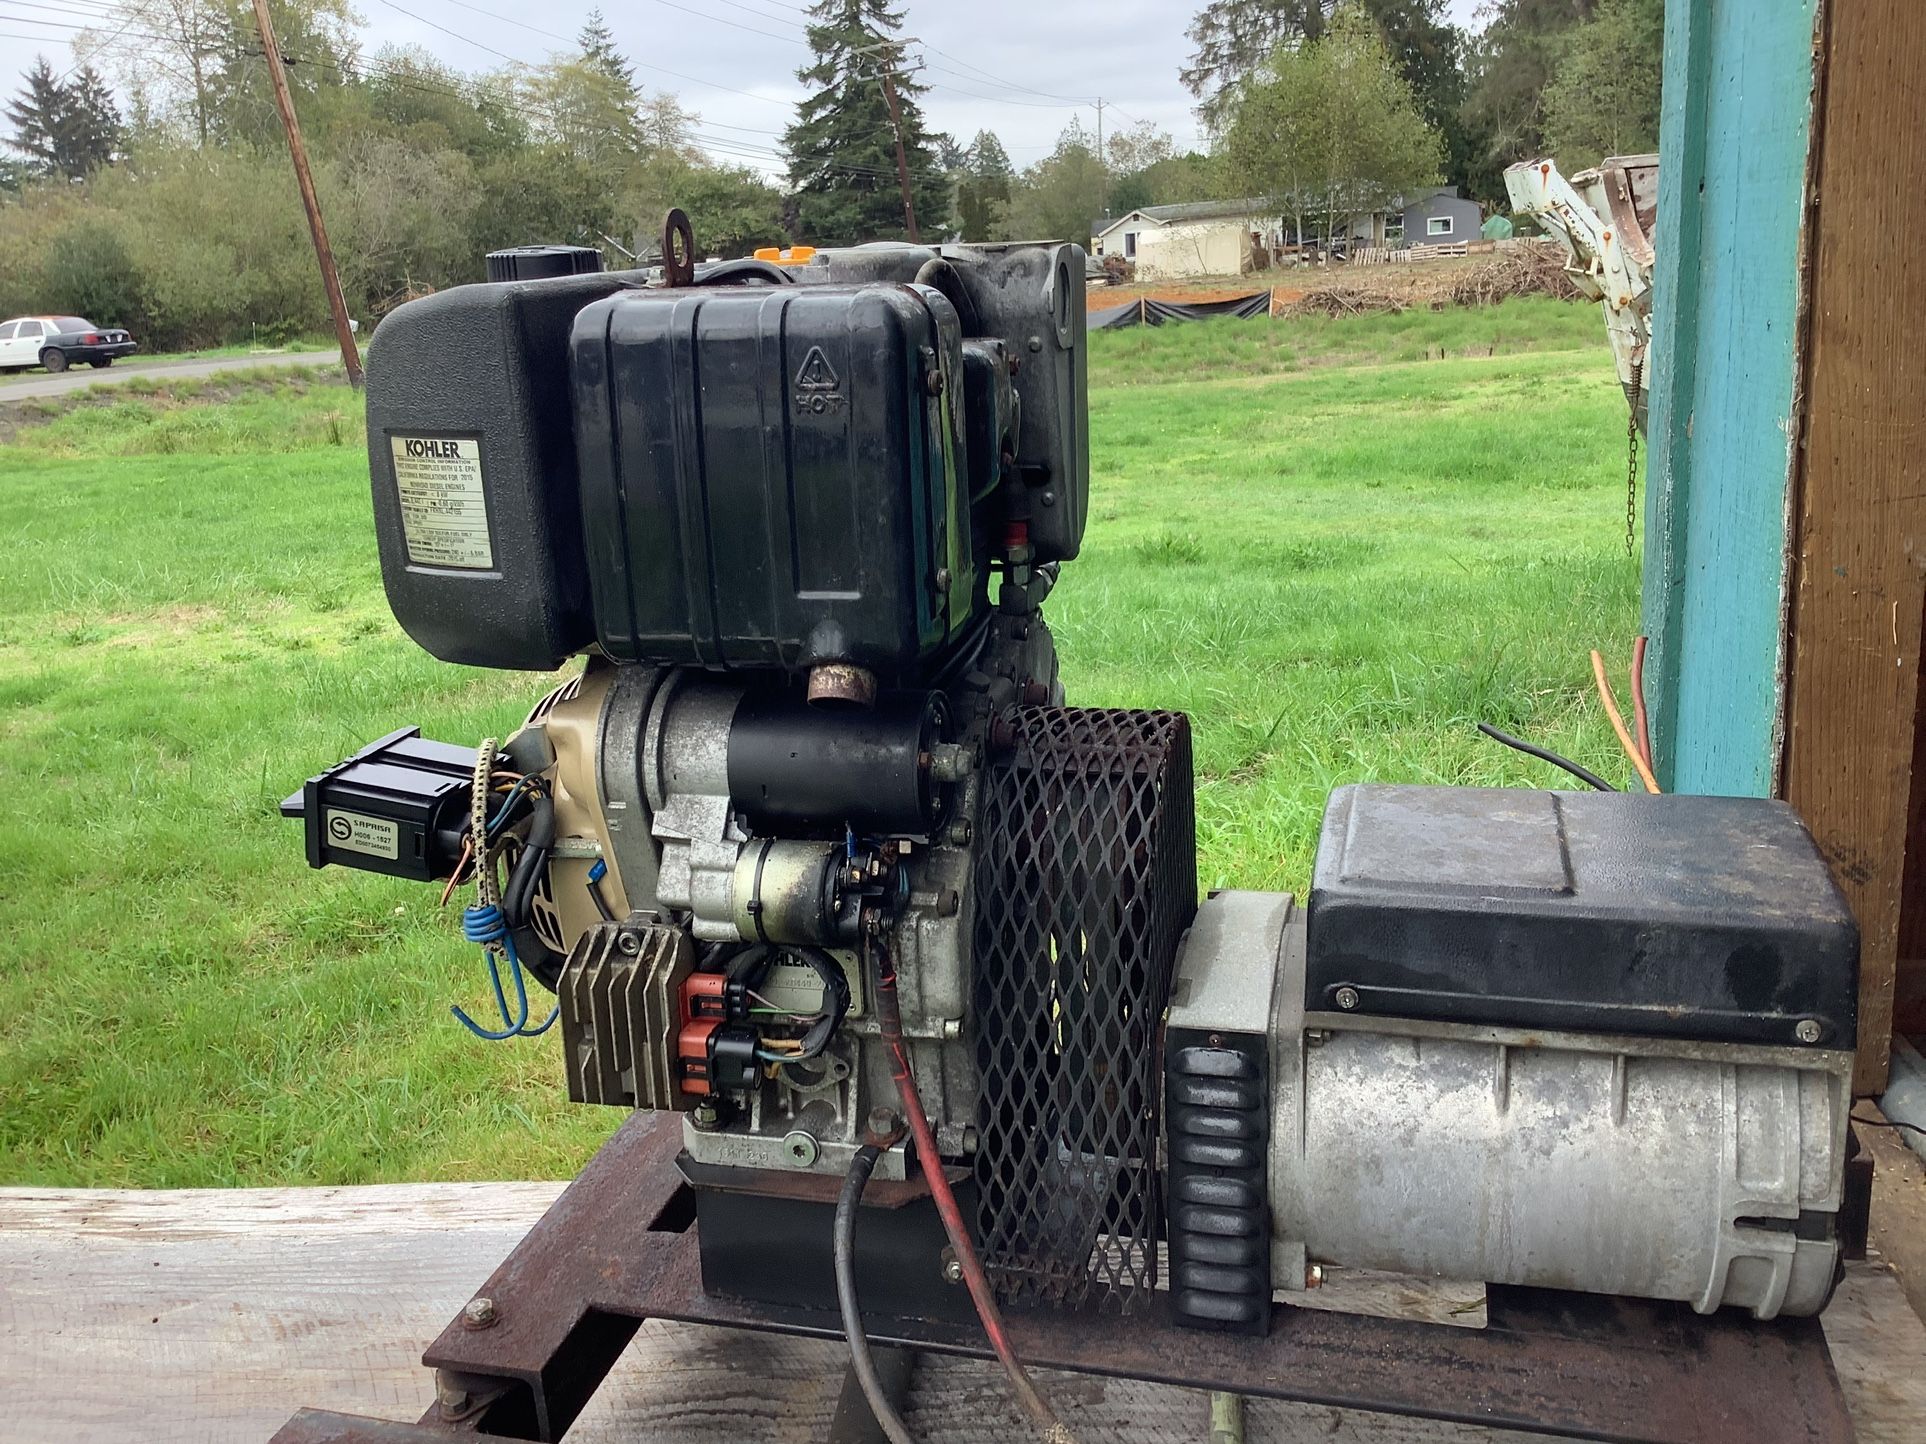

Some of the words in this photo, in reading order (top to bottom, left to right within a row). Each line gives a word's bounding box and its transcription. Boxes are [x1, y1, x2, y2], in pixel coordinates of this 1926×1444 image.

[795, 394, 846, 414] HOT
[405, 439, 460, 458] KOHLER
[353, 819, 391, 834] SAPRISA
